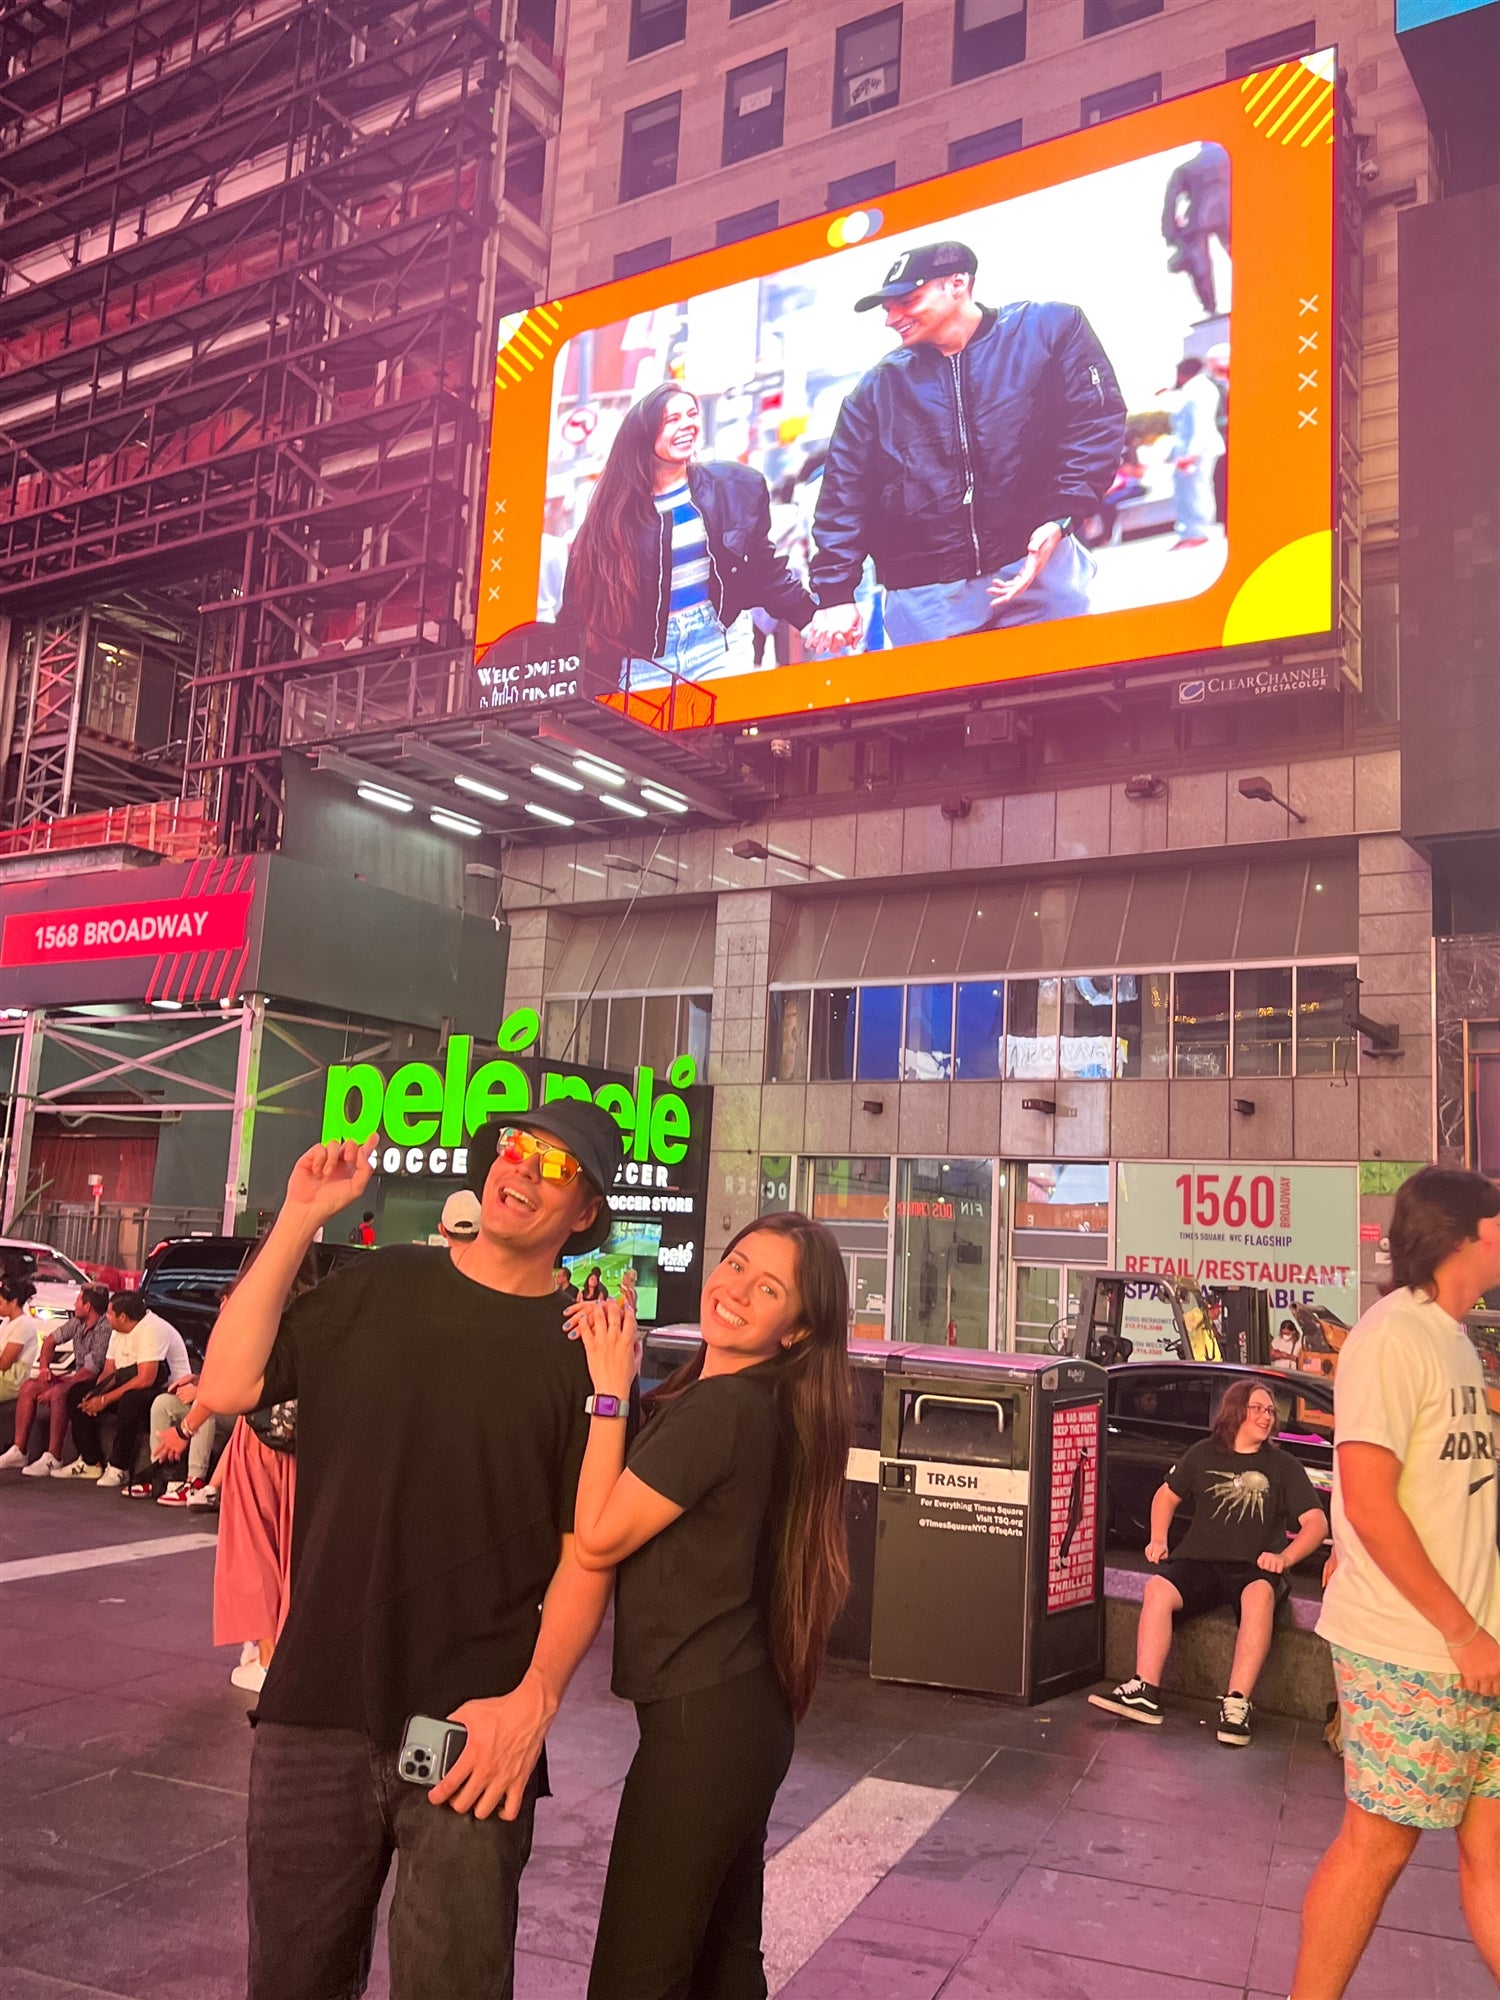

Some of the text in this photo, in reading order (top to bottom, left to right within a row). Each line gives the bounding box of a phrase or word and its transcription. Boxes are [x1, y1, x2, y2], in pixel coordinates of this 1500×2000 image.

[1255, 678, 1326, 695] SPECTACOLOR
[35, 911, 209, 950] 1568 BROADWAY
[321, 1008, 538, 1147] pelé
[368, 1147, 468, 1174] OCCE
[614, 1162, 668, 1187] CER
[606, 1195, 693, 1213] OCCER STORE
[1176, 1174, 1275, 1228] 1560
[1280, 1176, 1291, 1228] BROADWAY
[1179, 1231, 1292, 1247] TIMES SQUARE NYC FLAGSHIP
[1125, 1255, 1350, 1287] RETAIL/RESTAURANT
[1125, 1283, 1161, 1301] SPA
[927, 1472, 978, 1489] TRASH
[920, 1498, 1024, 1516] For Everything Times Square
[919, 1518, 1023, 1537] @TimesSquareNYC @TsqArts
[976, 1514, 1023, 1527] Visit TSQ.org
[1049, 1574, 1092, 1594] THRILLER
